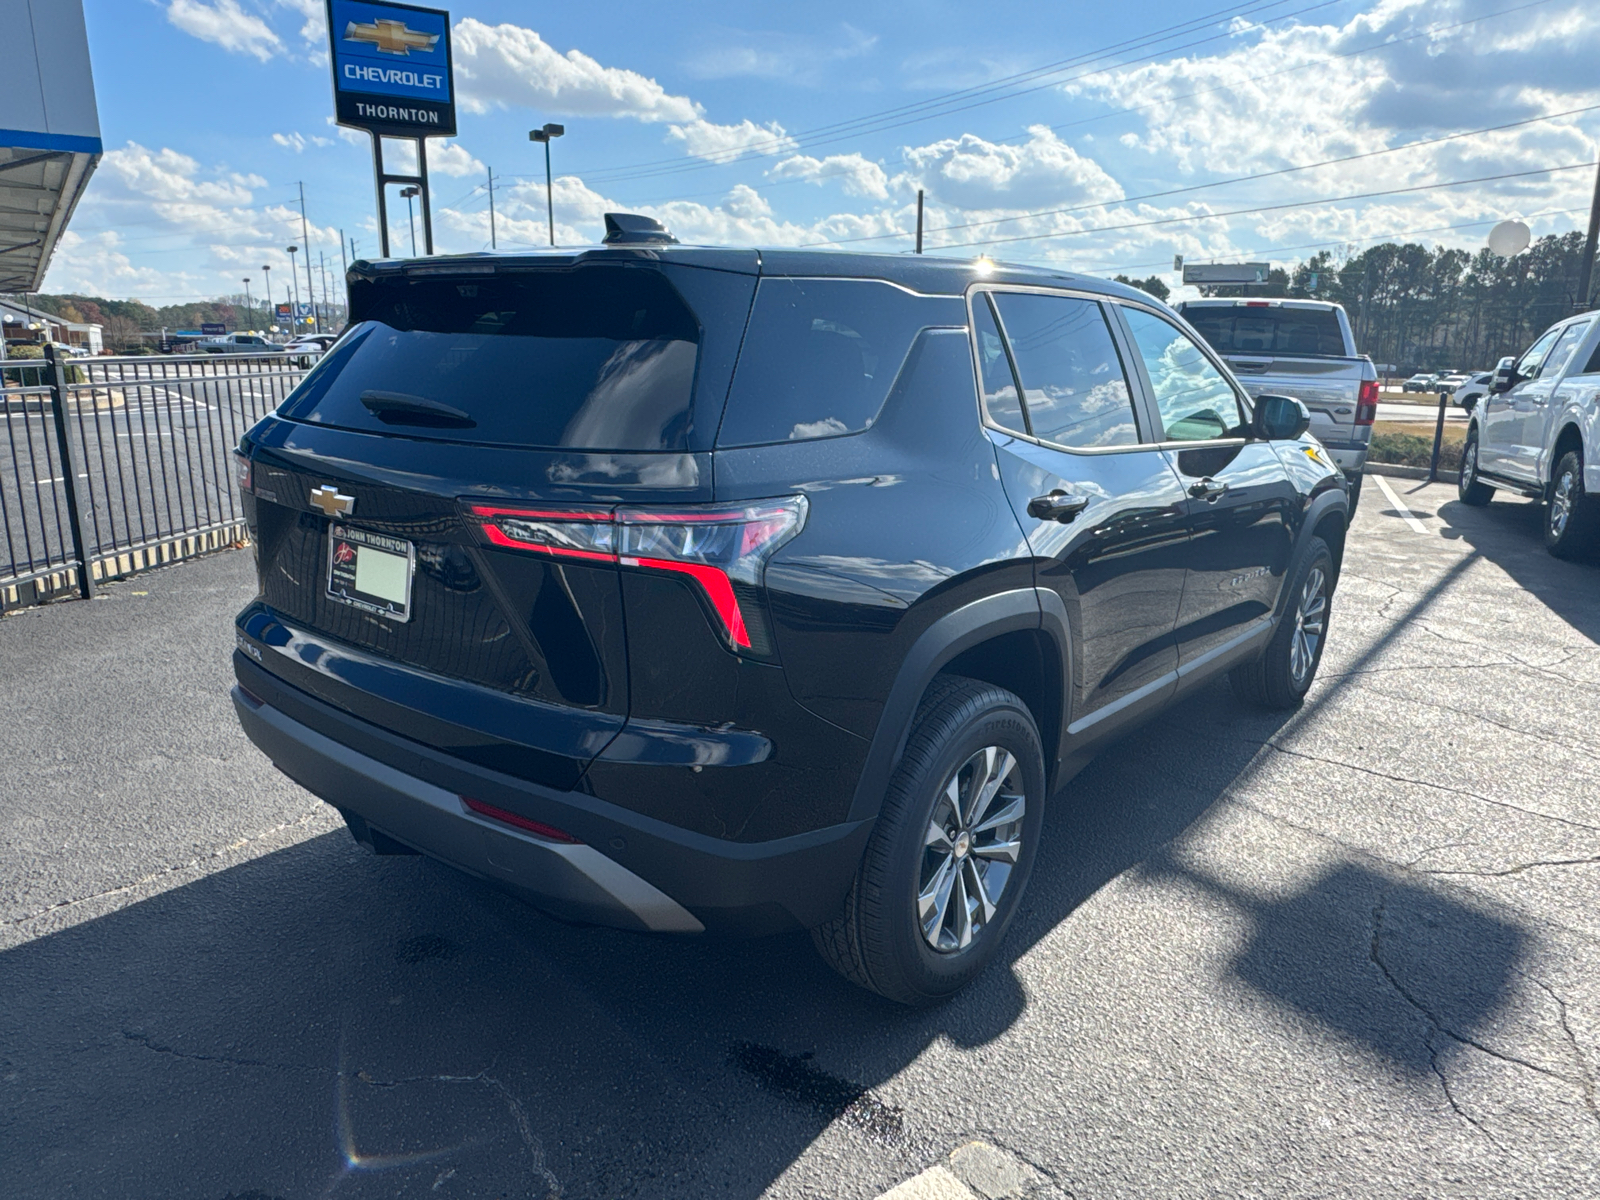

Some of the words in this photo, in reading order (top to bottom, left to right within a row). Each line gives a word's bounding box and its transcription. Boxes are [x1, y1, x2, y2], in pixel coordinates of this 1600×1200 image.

[344, 64, 443, 89] CHEVROLET
[356, 103, 438, 123] THORNTON
[347, 528, 365, 543] JOHN
[366, 533, 407, 552] THORNTON
[352, 601, 377, 612] CHEVROLET
[984, 718, 1031, 741] Firestone
